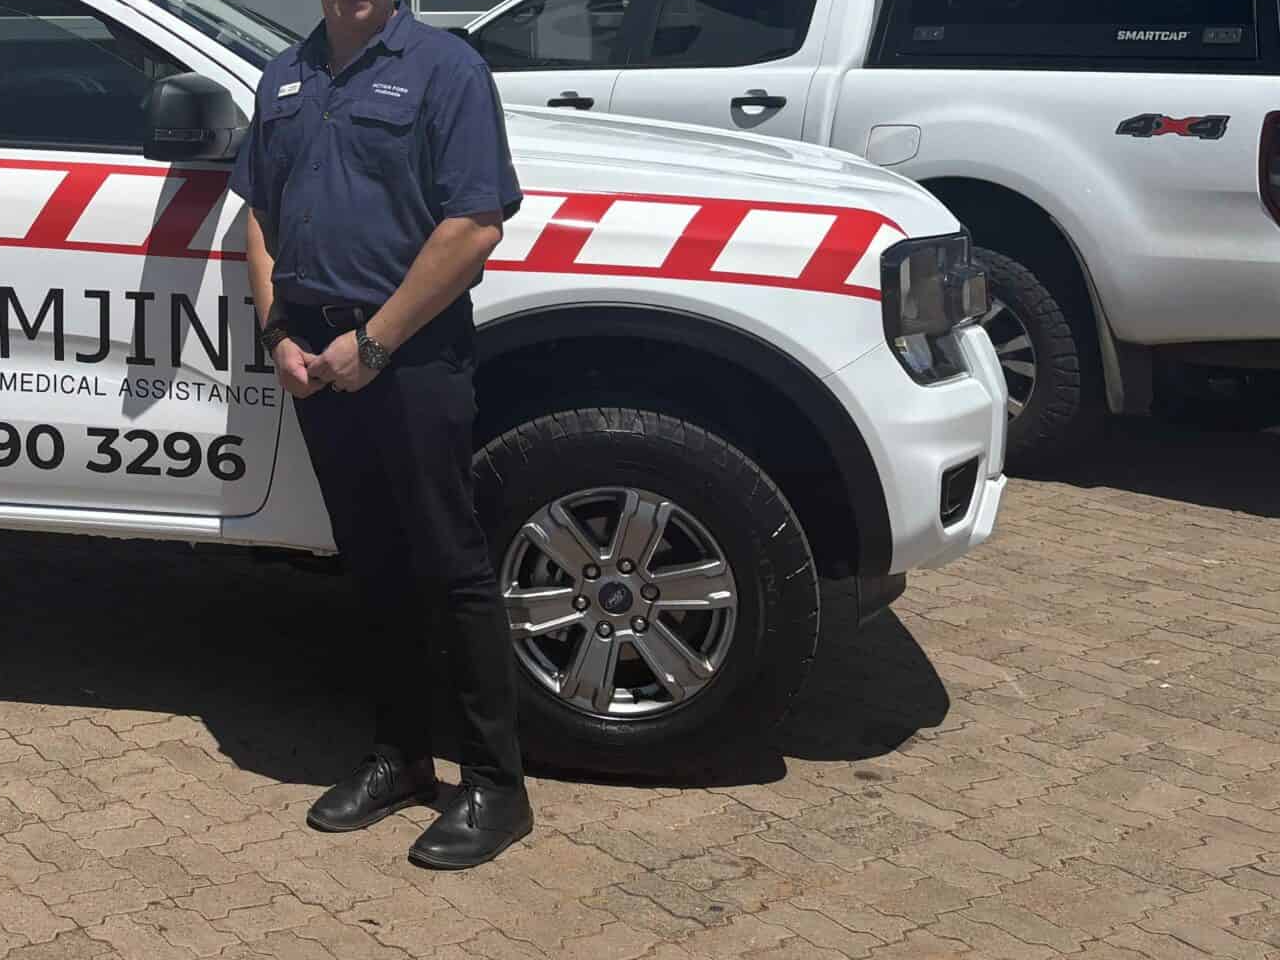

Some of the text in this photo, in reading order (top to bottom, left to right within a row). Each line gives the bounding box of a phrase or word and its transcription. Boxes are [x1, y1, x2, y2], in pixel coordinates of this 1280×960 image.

[1117, 30, 1188, 41] SMARTCAP
[0, 372, 276, 408] MEDICAL ASSISTANCE
[85, 428, 247, 482] 3296
